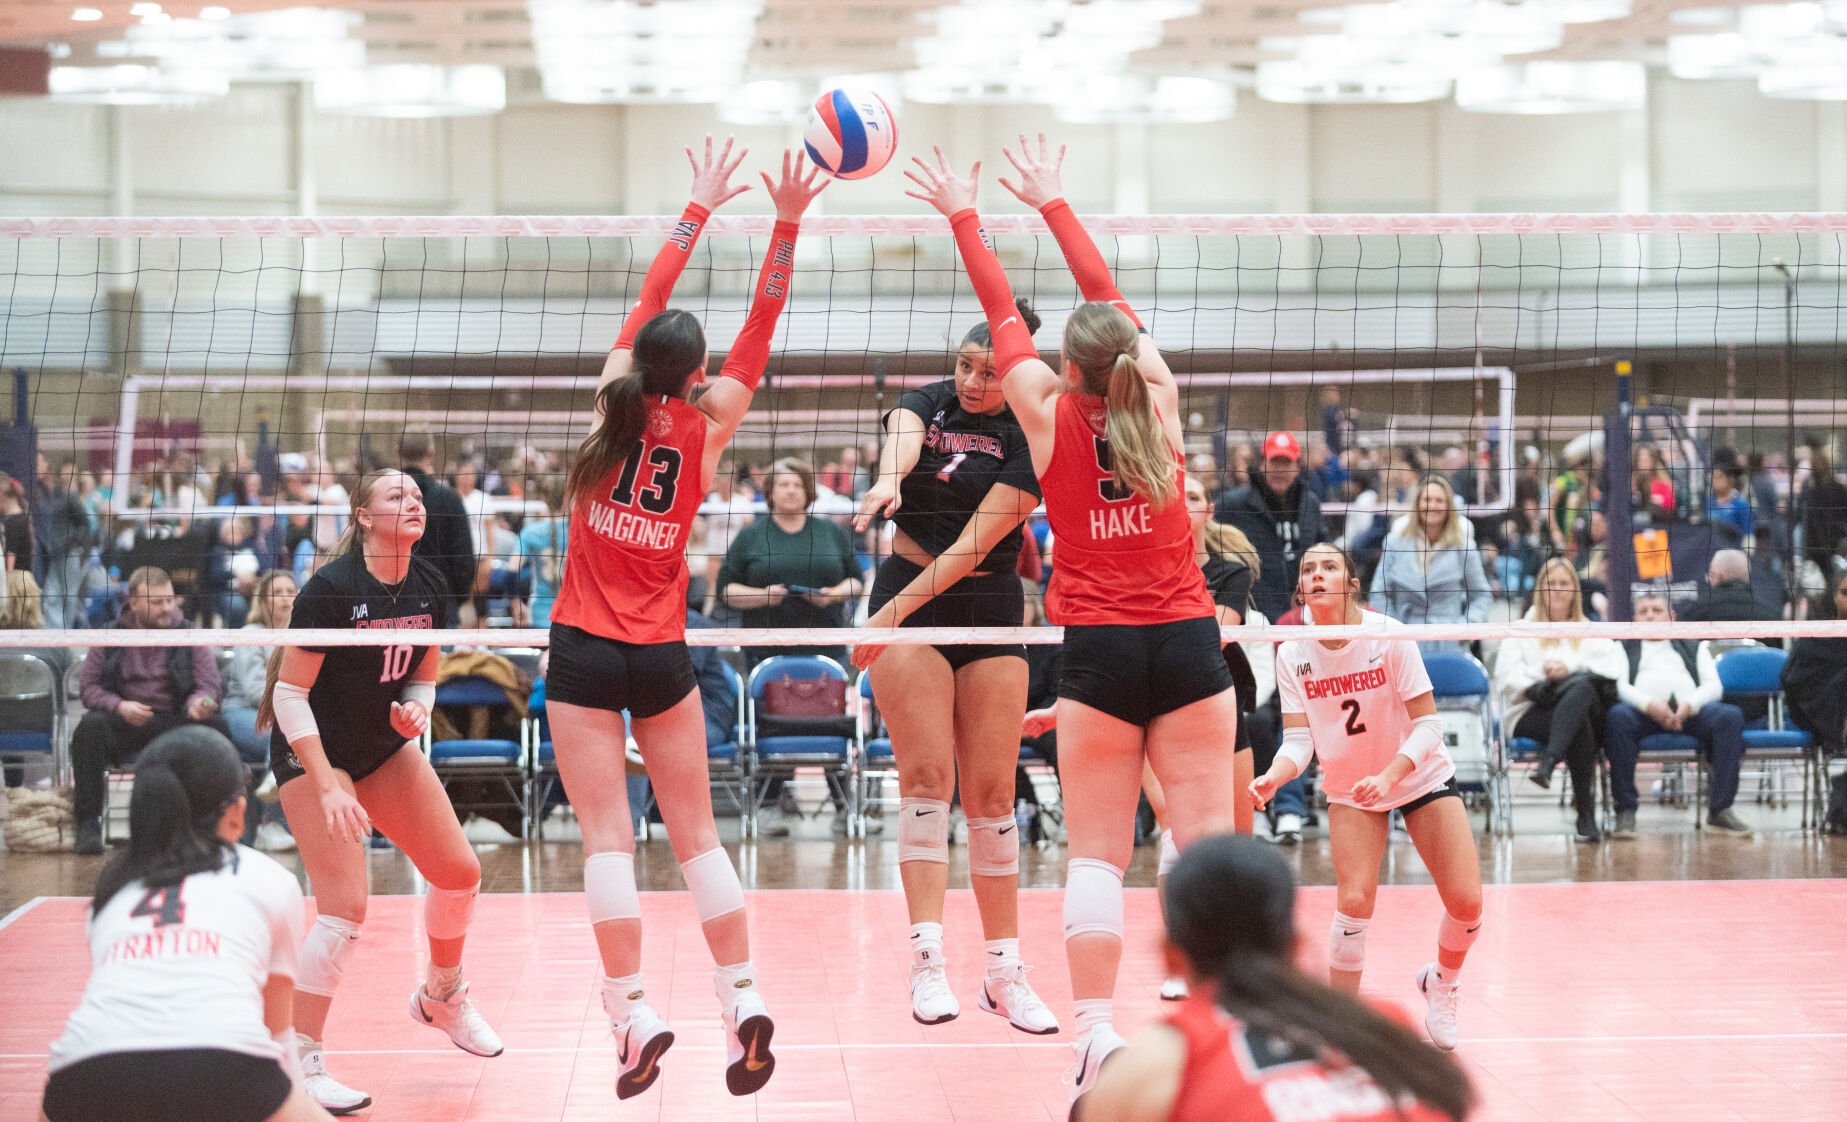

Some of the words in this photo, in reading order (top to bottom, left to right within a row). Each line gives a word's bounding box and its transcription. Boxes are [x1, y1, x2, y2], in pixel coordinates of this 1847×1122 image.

[669, 221, 698, 250] JVA
[772, 238, 795, 268] PHIL
[609, 439, 683, 516] 13
[587, 499, 681, 551] WAGONER
[1089, 502, 1154, 541] HAKE
[350, 603, 369, 621] JVA
[379, 644, 415, 684] 10
[1296, 662, 1312, 677] JVA
[1304, 667, 1387, 699] EMPOWERED
[1341, 699, 1367, 736] 2
[128, 875, 186, 928] 4
